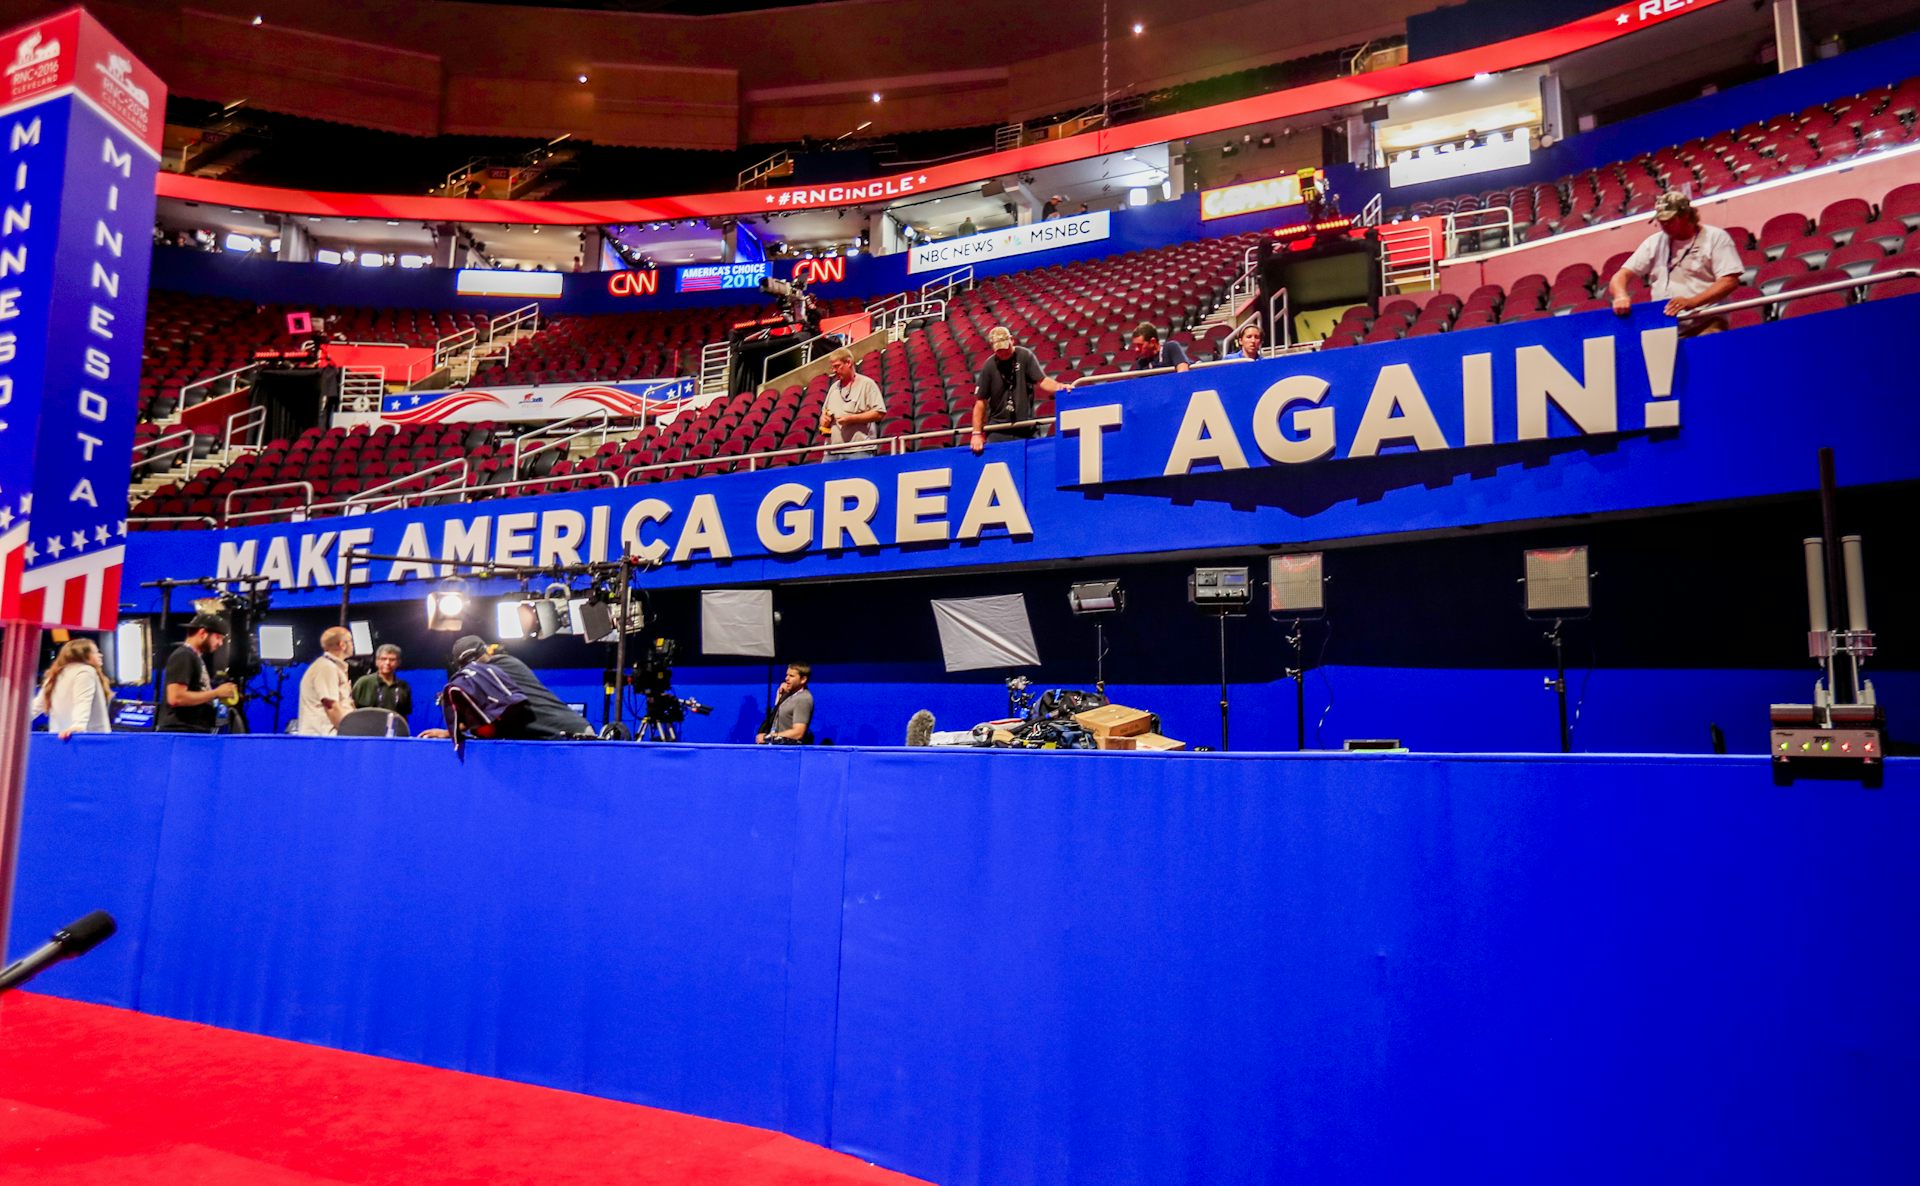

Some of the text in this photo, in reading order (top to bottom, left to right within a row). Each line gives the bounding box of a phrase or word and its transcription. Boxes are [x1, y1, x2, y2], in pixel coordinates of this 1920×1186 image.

[12, 73, 58, 96] CLEVELAND
[919, 220, 1091, 265] NBC NEWS MSNBC
[608, 270, 658, 297] CNN
[682, 263, 766, 279] AMERICA'S CHOICE
[792, 256, 845, 285] CNN
[69, 137, 131, 508] MINNESOTA
[1060, 326, 1680, 485] T AGAIN!
[216, 462, 1034, 593] MAKE AMERICA GREA
